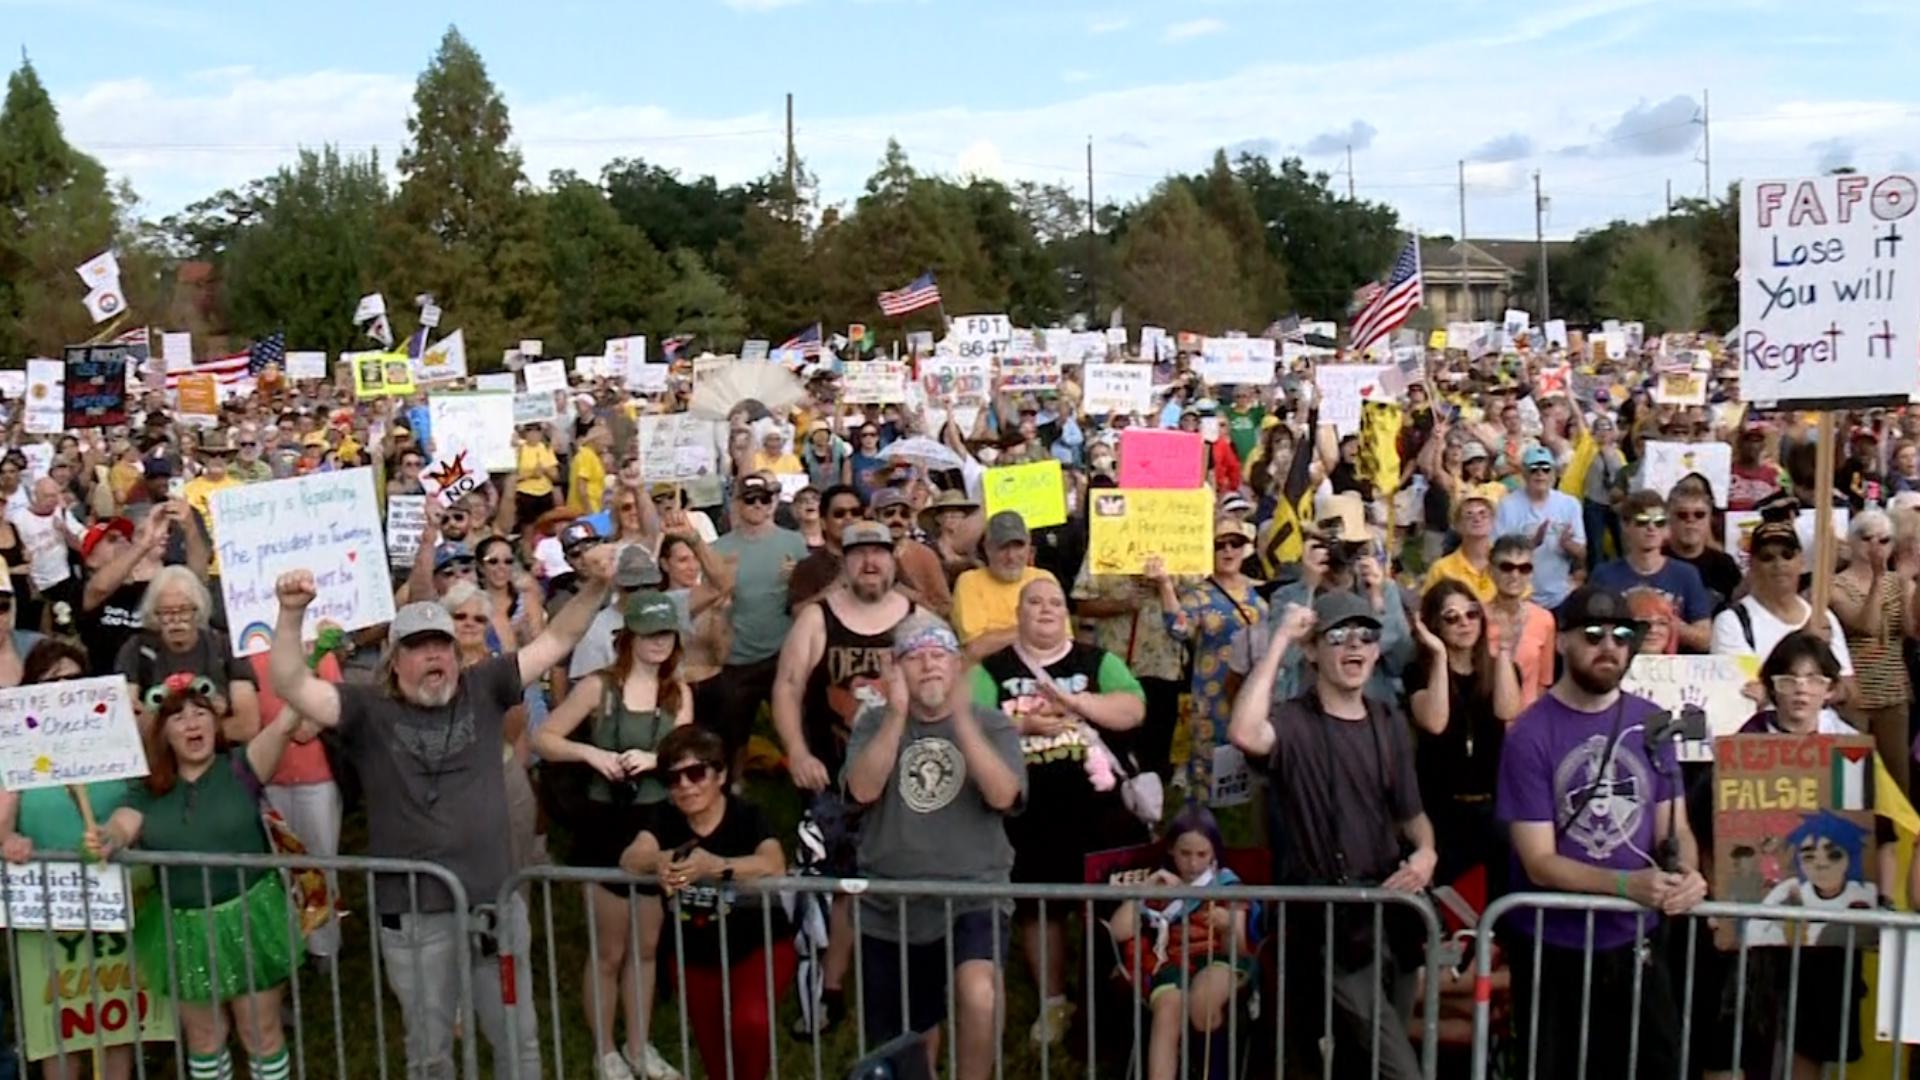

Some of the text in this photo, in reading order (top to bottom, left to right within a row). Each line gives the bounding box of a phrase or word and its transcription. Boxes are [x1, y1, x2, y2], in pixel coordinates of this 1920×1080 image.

[1757, 175, 1918, 228] FAFO
[1772, 222, 1903, 267] Lose it
[1756, 268, 1896, 320] You will
[967, 318, 1002, 334] FDT
[959, 340, 1009, 358] 8647
[1743, 319, 1896, 382] Regret it
[444, 476, 475, 502] NO
[219, 540, 251, 567] The
[1716, 735, 1836, 771] REJECT
[1718, 776, 1820, 811] FALSE
[58, 933, 127, 962] YES
[61, 988, 149, 1039] NO!
